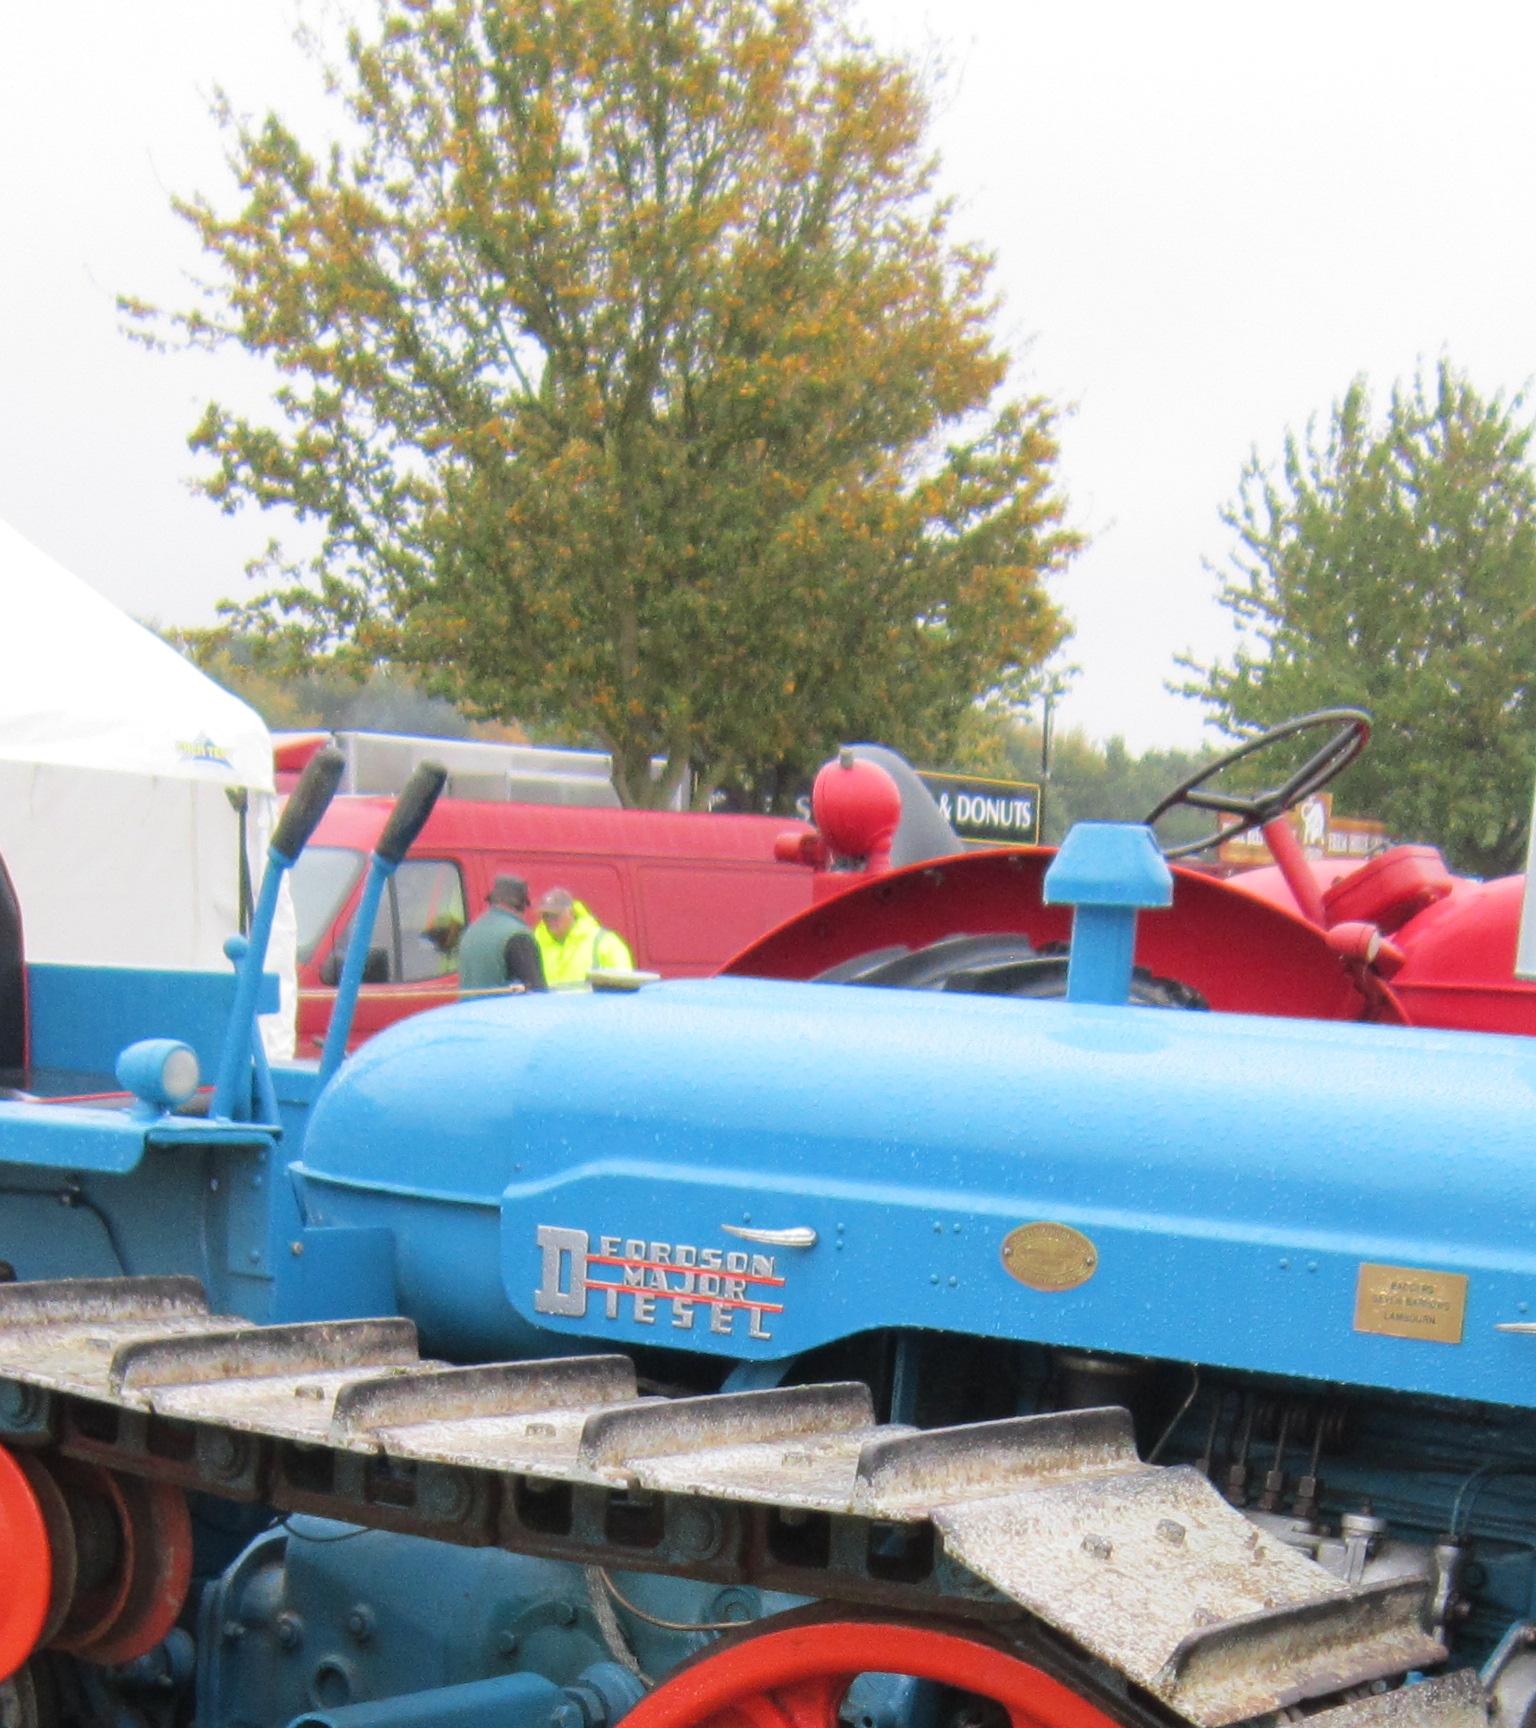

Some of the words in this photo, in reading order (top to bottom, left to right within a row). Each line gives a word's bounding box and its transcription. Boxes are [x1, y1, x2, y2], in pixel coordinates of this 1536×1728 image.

[956, 794, 1032, 827] DONUTS
[599, 1235, 775, 1278] FORDSON
[622, 1263, 747, 1302] MAJOR
